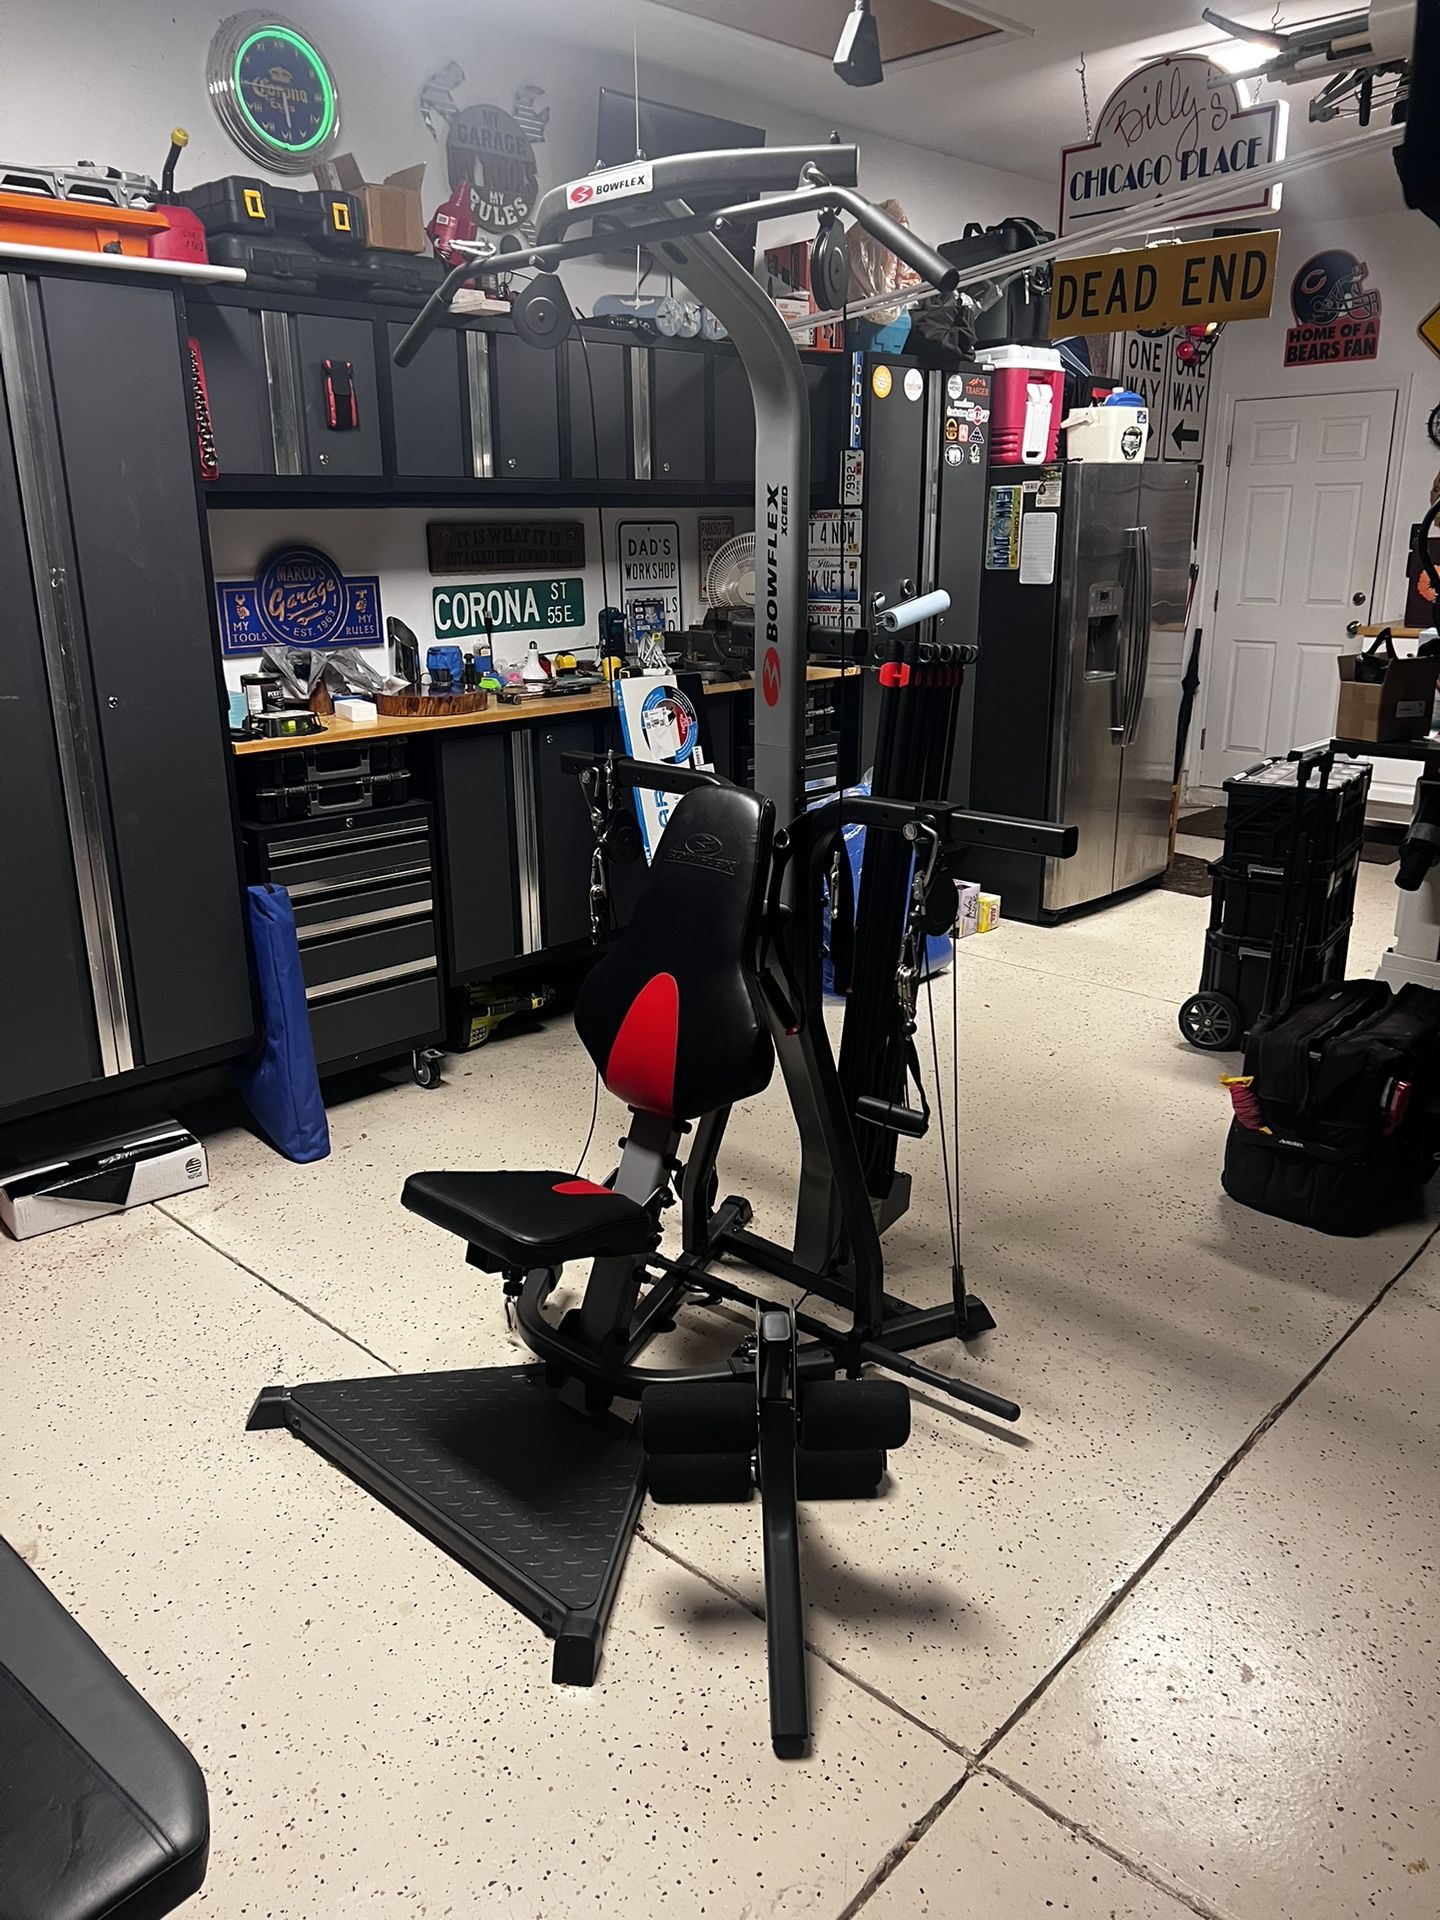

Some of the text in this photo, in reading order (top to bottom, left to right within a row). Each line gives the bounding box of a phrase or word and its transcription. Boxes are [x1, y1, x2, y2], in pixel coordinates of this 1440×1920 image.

[252, 76, 308, 104] Corona
[270, 98, 296, 113] Exa
[1106, 66, 1228, 163] Billy's
[457, 123, 528, 156] GARAGE
[1069, 136, 1263, 201] CHICAGO PLACE
[489, 190, 504, 205] MY
[596, 175, 645, 195] BOWFLEX
[470, 187, 528, 226] RULES
[1056, 250, 1268, 320] DEAD END
[1289, 321, 1376, 343] HOME OF A
[1128, 338, 1163, 373] ONE
[1286, 337, 1377, 363] BEARS FAN
[1126, 376, 1161, 409] WAY
[1173, 382, 1205, 413] WAY
[845, 465, 856, 498] 7992
[781, 484, 789, 537] XCEED
[474, 530, 486, 545] IS
[488, 527, 531, 544] WHAT
[820, 522, 827, 544] 4
[628, 538, 671, 556] DAD'S
[277, 565, 326, 582] MARCO'S
[625, 562, 676, 580] WORKSHOP
[766, 483, 780, 644] BOWFLEX
[811, 558, 842, 569] Illino
[268, 578, 336, 622] Garage
[434, 582, 567, 631] CORONA ST
[233, 621, 249, 631] MY
[293, 610, 336, 637] EST. 1963
[346, 624, 375, 635] RULES
[358, 614, 372, 623] MY
[232, 632, 267, 643] TOOLS
